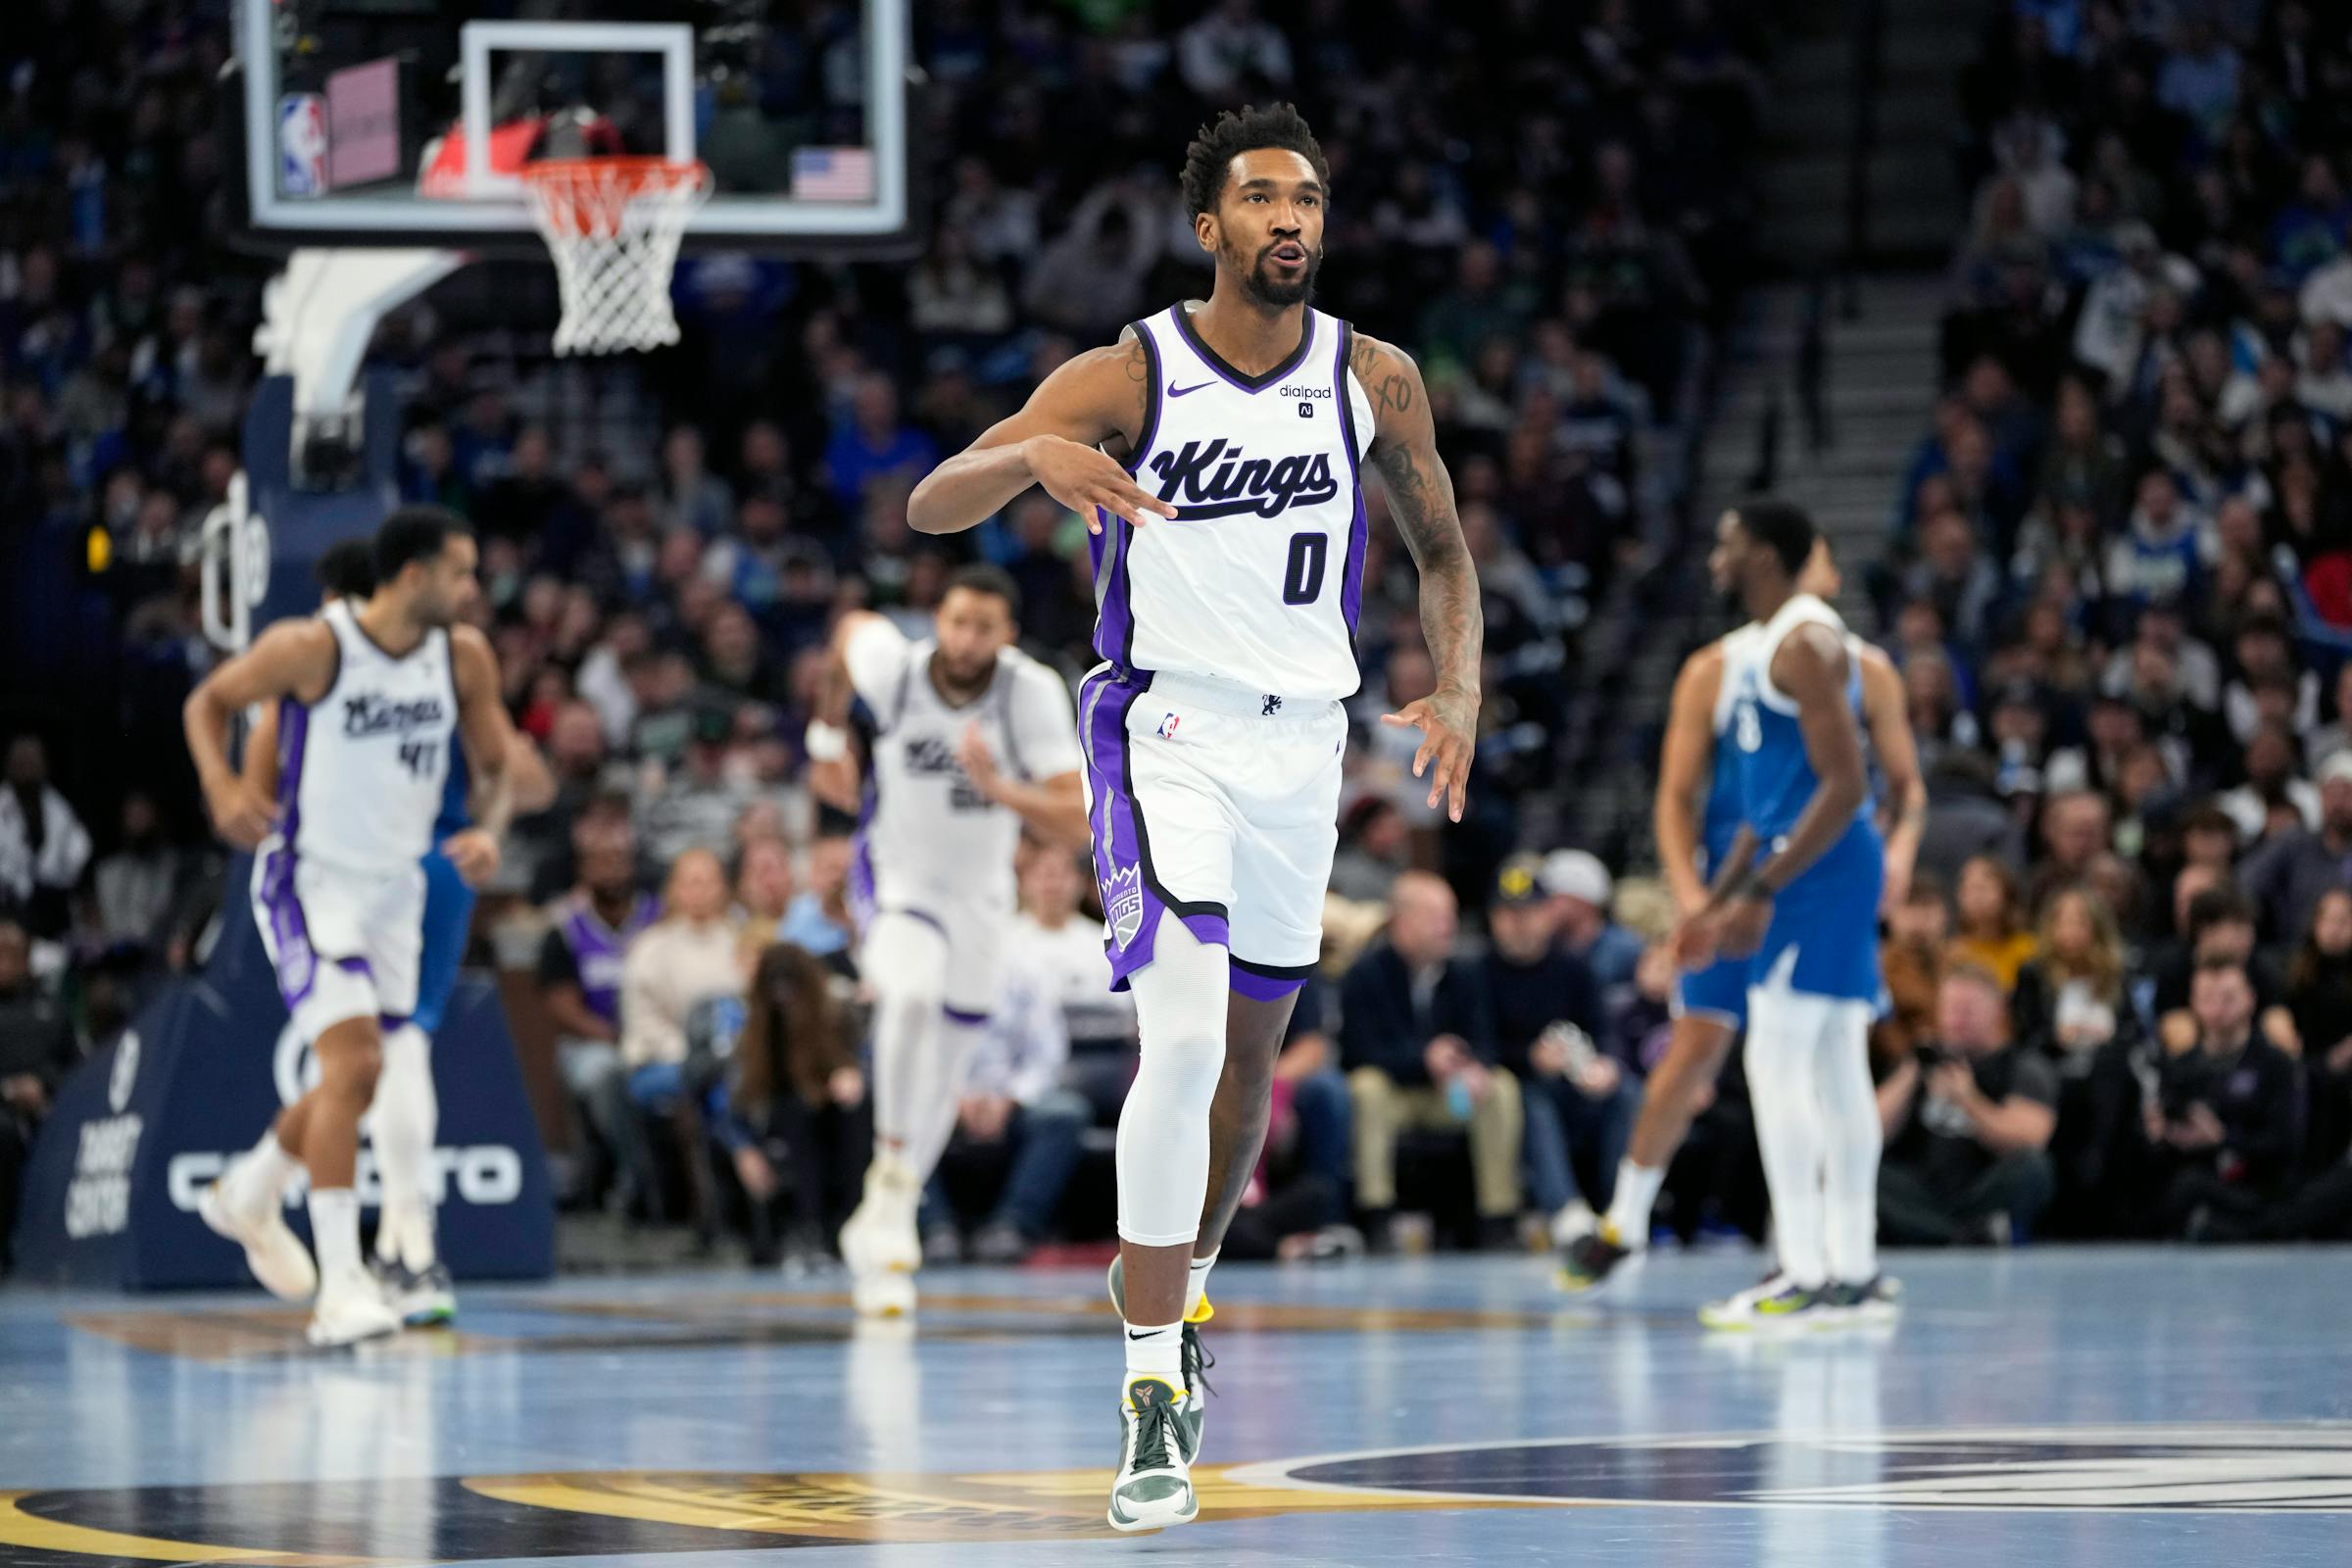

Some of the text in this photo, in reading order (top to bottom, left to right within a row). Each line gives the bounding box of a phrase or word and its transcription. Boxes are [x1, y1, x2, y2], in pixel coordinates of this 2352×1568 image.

[1280, 384, 1331, 401] dialpad
[1150, 438, 1338, 518] Kings
[1283, 532, 1328, 606] 0
